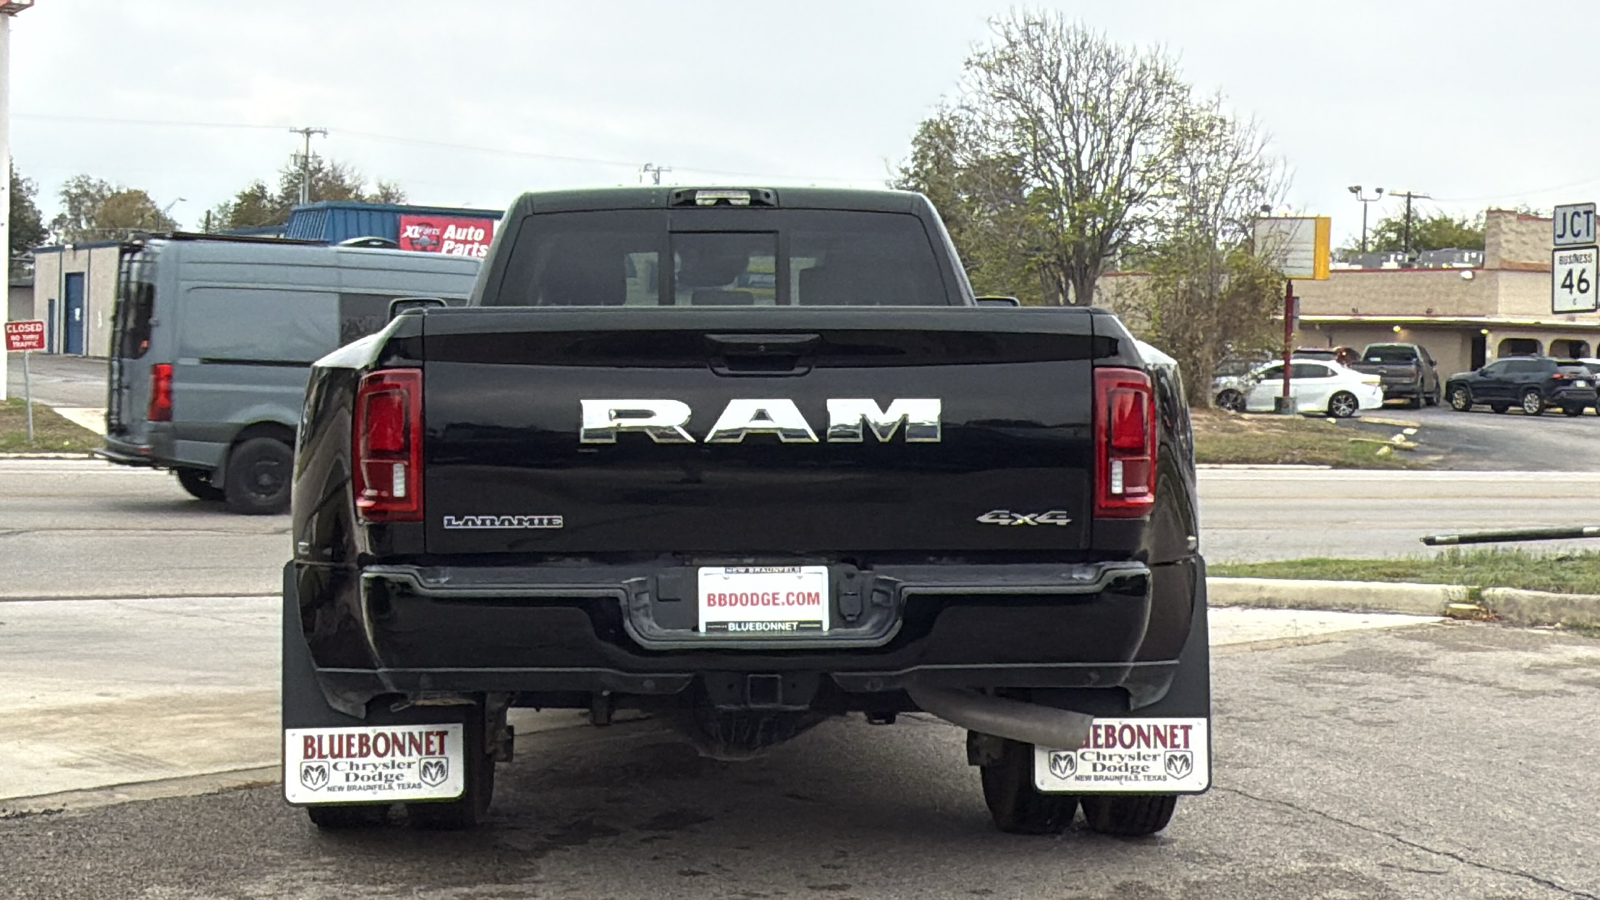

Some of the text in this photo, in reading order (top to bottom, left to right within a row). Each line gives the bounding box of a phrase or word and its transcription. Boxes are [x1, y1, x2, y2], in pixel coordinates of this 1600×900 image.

[1557, 210, 1593, 238] JCT
[443, 224, 485, 242] Auto
[441, 240, 489, 258] Parts
[1559, 253, 1593, 265] BUSINESS
[1561, 268, 1590, 295] 46
[6, 323, 43, 333] CLOSED
[580, 398, 941, 443] RAM
[443, 515, 563, 529] LARAMIE
[707, 592, 821, 607] BBDODGE.COM
[728, 621, 799, 632] BLUEBONNET
[303, 730, 449, 760] BLUEBONNET
[1079, 750, 1161, 764] Chrysler
[332, 759, 417, 774] Chrysler
[1092, 762, 1151, 775] Dodge
[344, 771, 405, 784] Dodge
[1074, 774, 1092, 782] NEW
[1143, 774, 1168, 782] TEXAS
[396, 782, 423, 790] TEXAS
